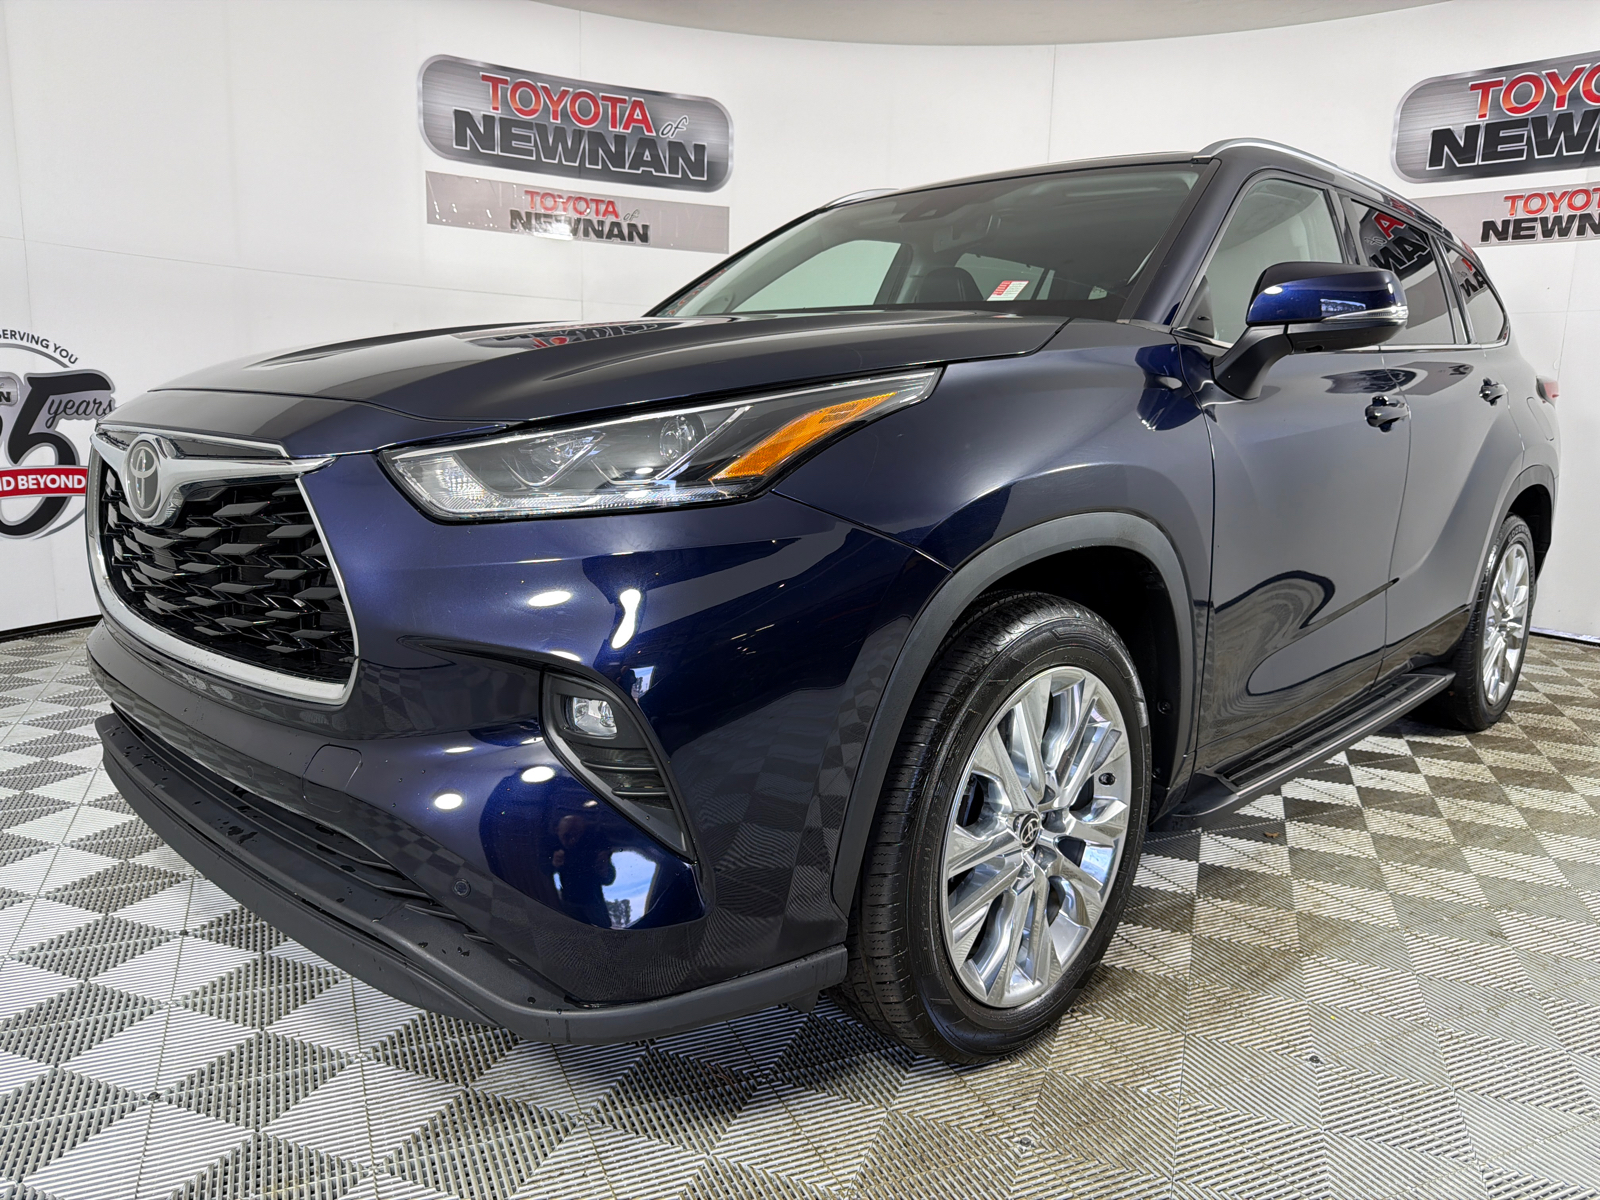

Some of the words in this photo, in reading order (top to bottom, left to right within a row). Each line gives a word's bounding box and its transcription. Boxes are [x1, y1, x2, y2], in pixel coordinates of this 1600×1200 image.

[480, 72, 656, 135] TOYOTA
[659, 116, 688, 138] of
[453, 108, 708, 180] NEWNAN
[1426, 108, 1600, 170] NEW
[524, 190, 620, 219] TOYOTA
[623, 209, 640, 221] of
[0, 329, 50, 350] ERVING
[53, 343, 79, 365] YOU
[45, 398, 113, 429] years
[17, 474, 86, 490] BEYOND
